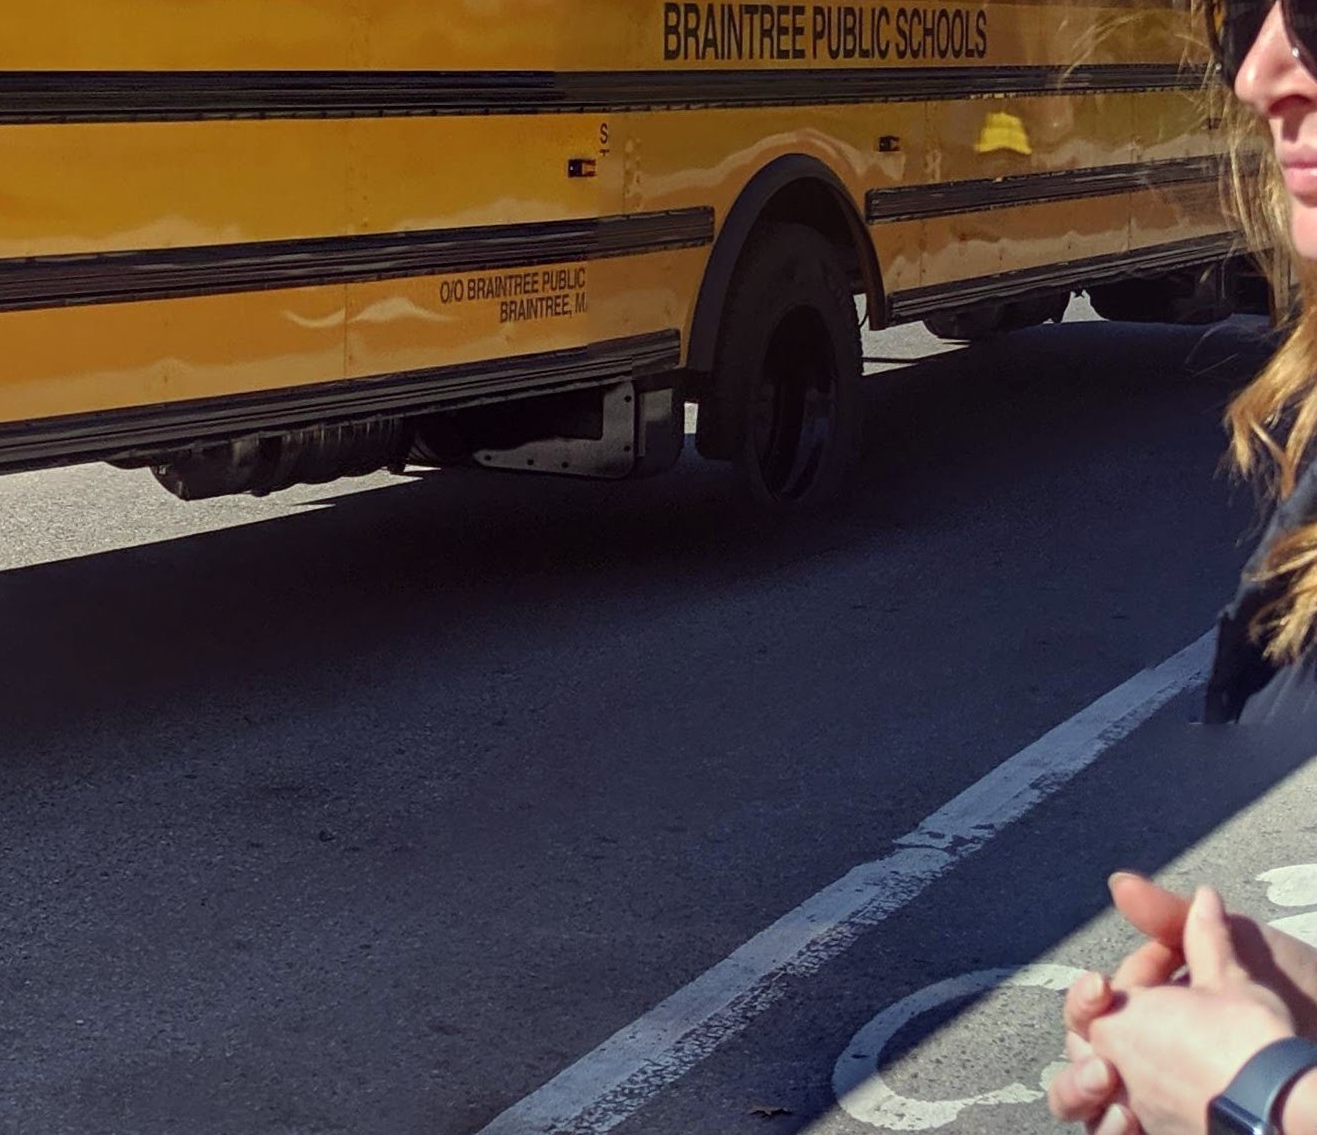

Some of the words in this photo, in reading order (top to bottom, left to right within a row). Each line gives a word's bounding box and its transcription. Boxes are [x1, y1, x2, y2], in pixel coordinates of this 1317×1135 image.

[663, 2, 805, 61] BRAINTREE
[812, 6, 890, 59] PUBLIC
[895, 7, 988, 60] SCHOOLS
[439, 279, 464, 304] O/O
[467, 272, 539, 300] BRAINTREE
[542, 268, 586, 293] PUBLIC
[500, 293, 573, 323] BRAINTREE,
[575, 292, 587, 313] M
